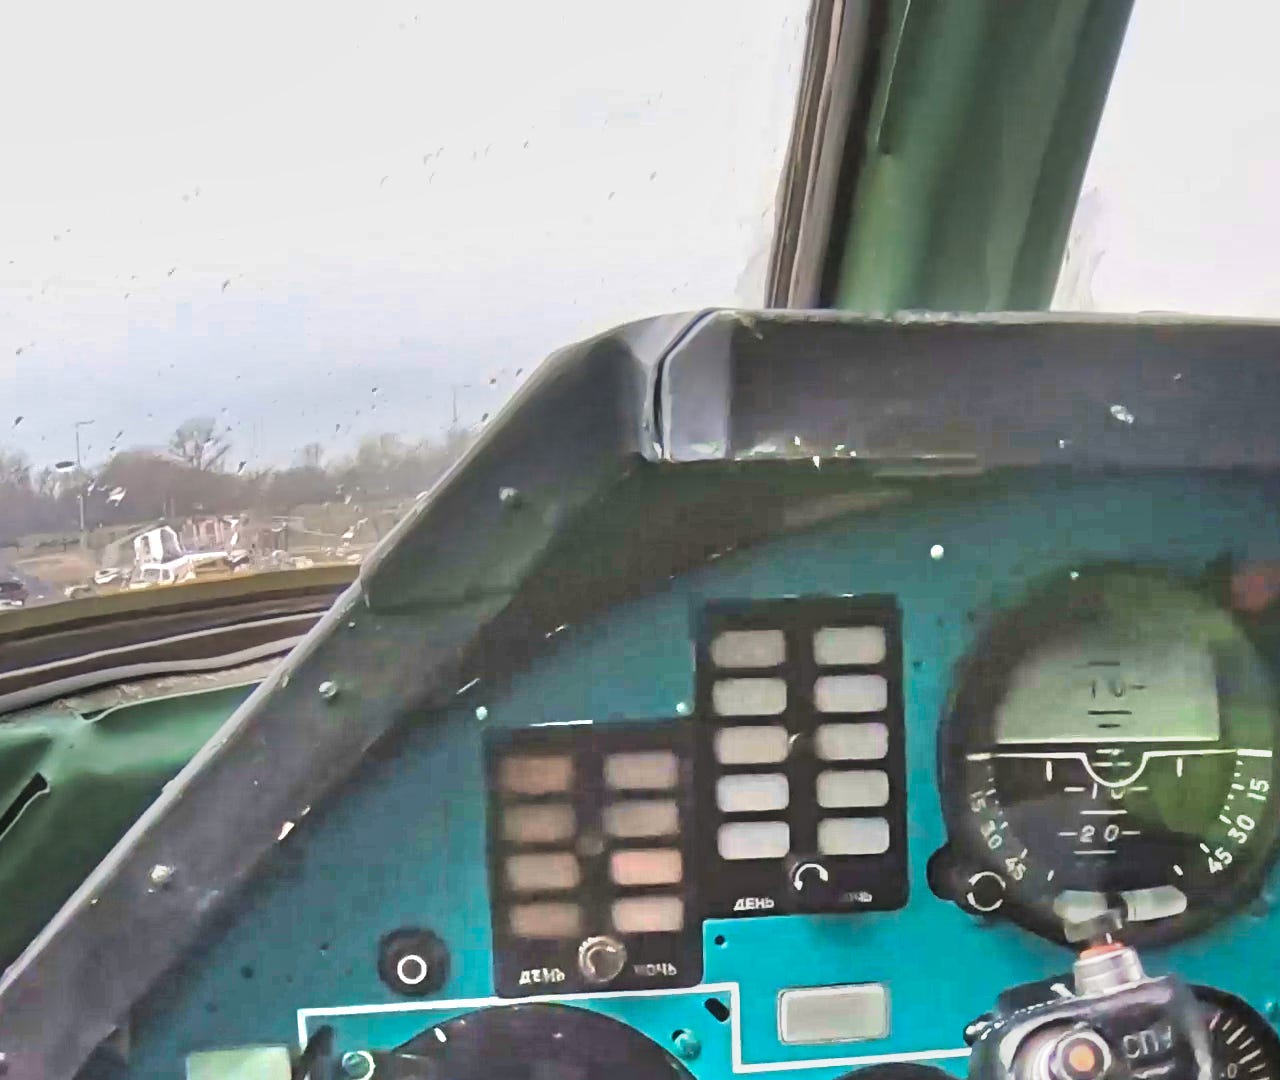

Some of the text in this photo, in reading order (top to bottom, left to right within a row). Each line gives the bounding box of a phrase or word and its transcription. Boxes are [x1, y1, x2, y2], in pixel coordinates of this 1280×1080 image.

[1227, 814, 1255, 844] 30
[1208, 846, 1233, 873] 45
[733, 896, 775, 911] ДЕНЬ
